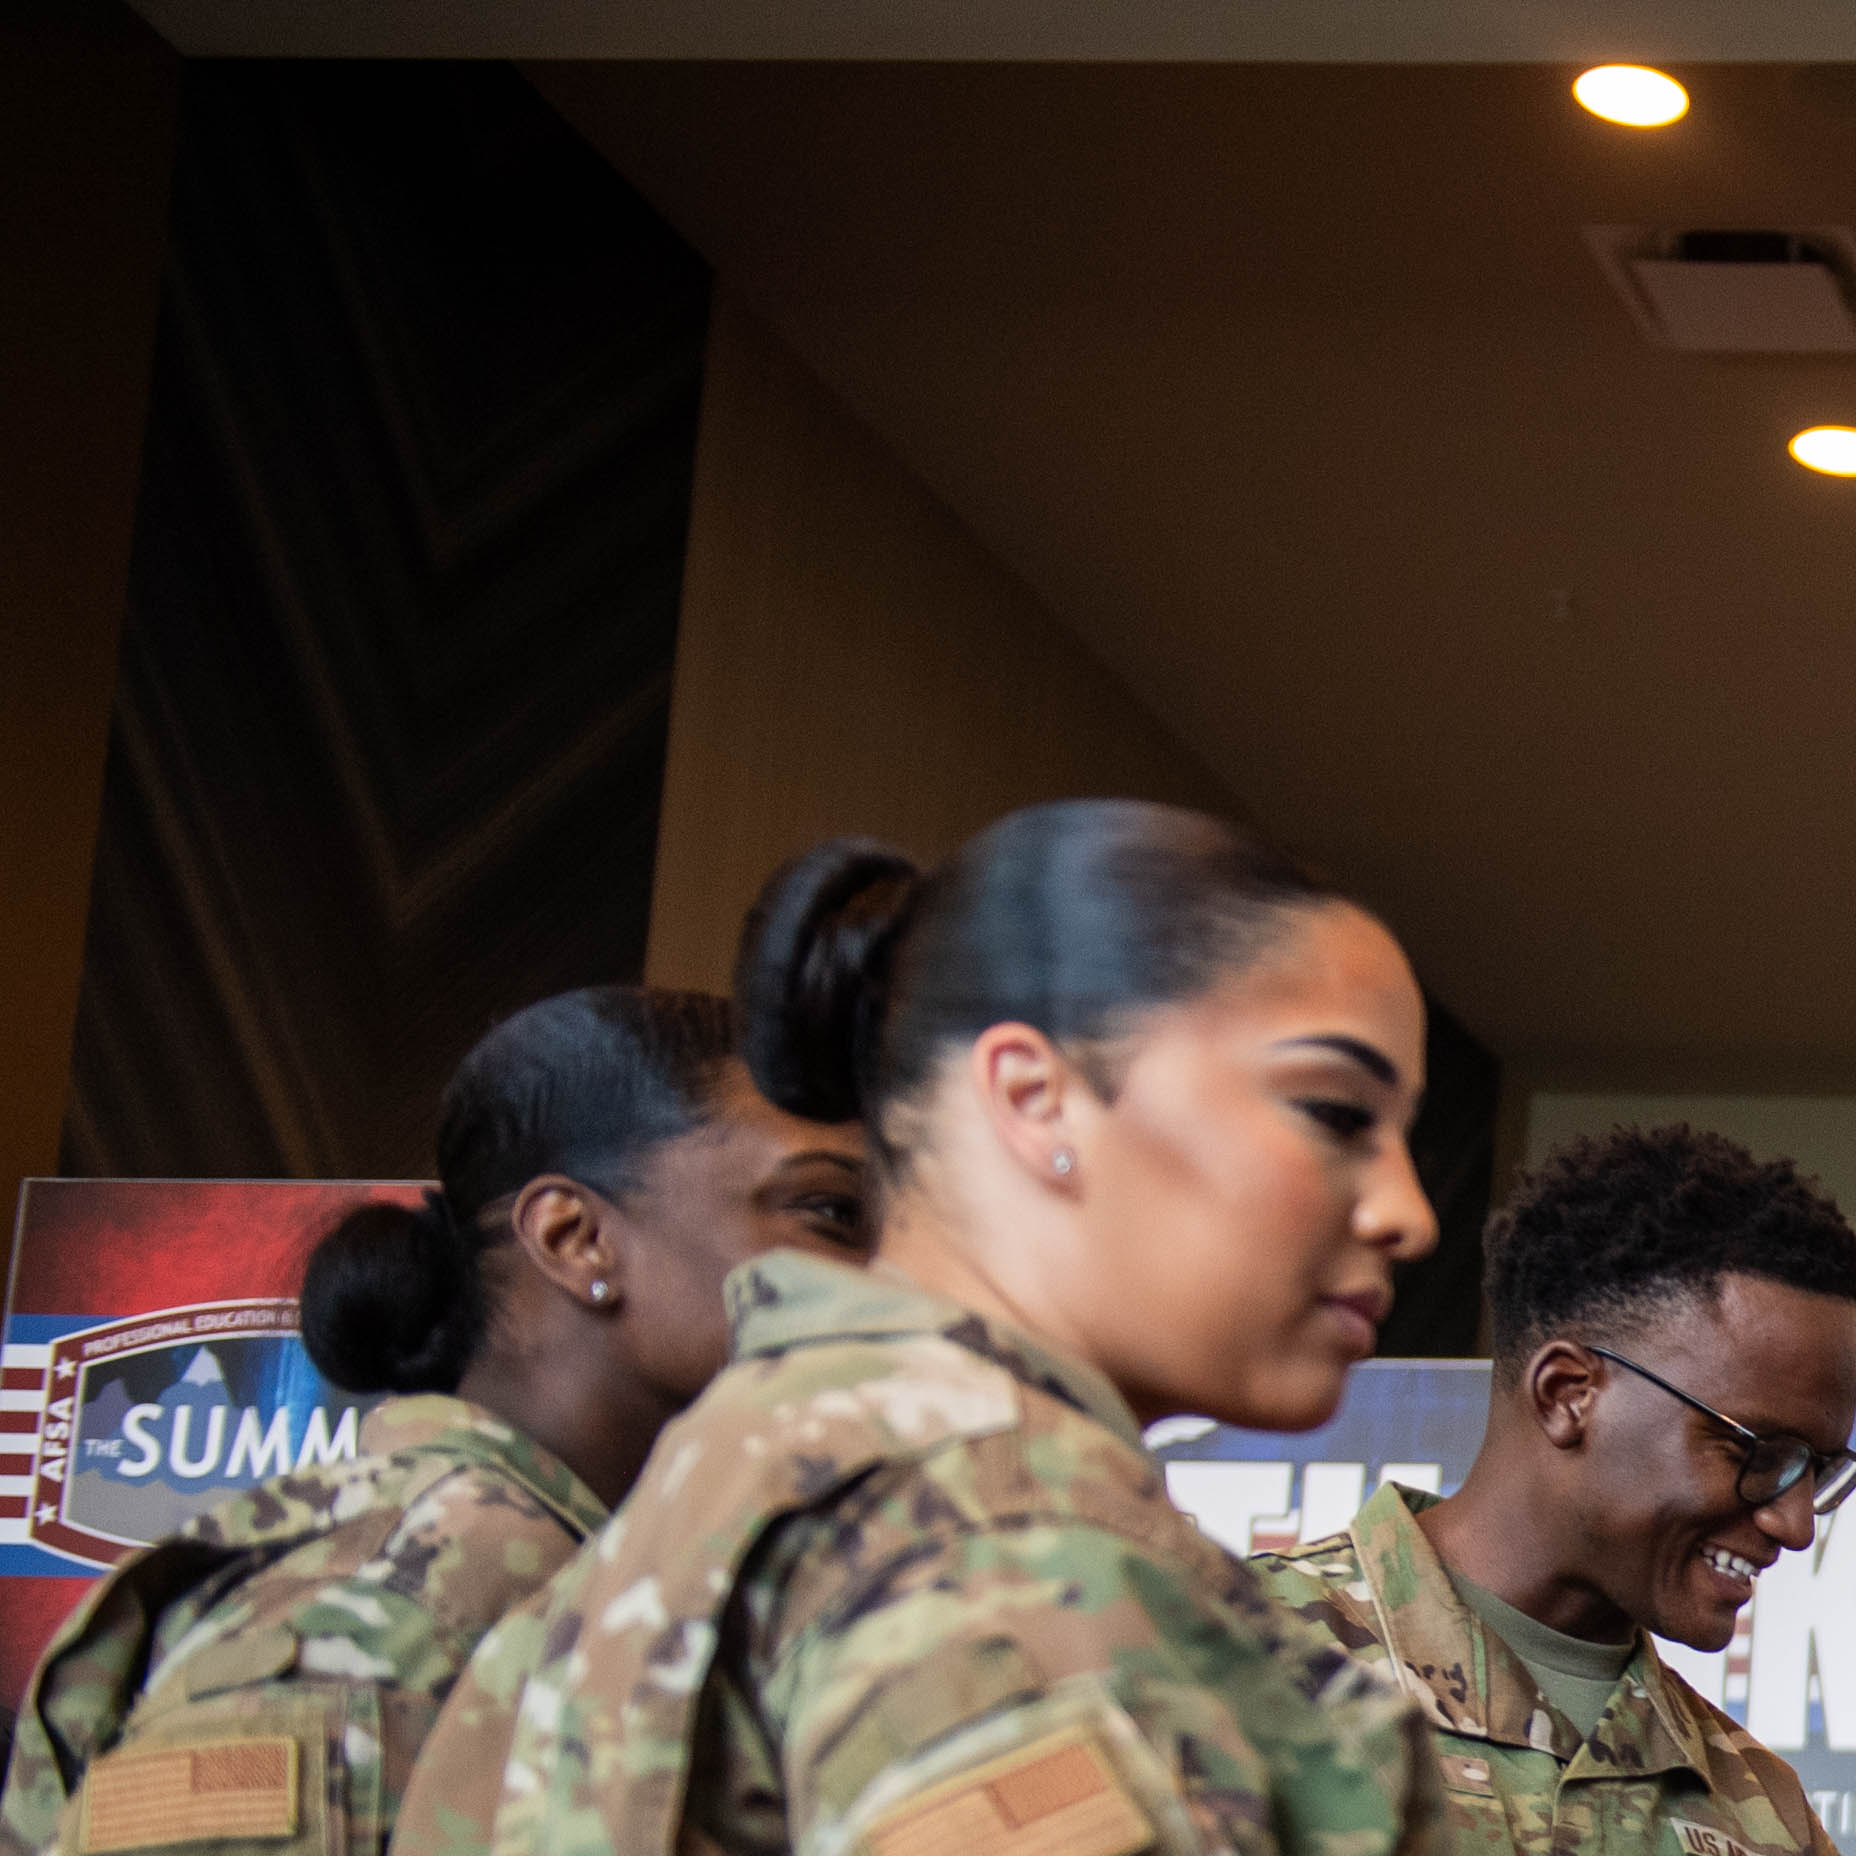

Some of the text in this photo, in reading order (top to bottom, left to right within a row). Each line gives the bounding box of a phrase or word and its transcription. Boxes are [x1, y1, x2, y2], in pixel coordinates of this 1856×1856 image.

[193, 1308, 275, 1333] EDUCATION
[40, 1397, 74, 1483] AFSA
[83, 1438, 124, 1458] THE
[116, 1402, 360, 1479] SUMM
